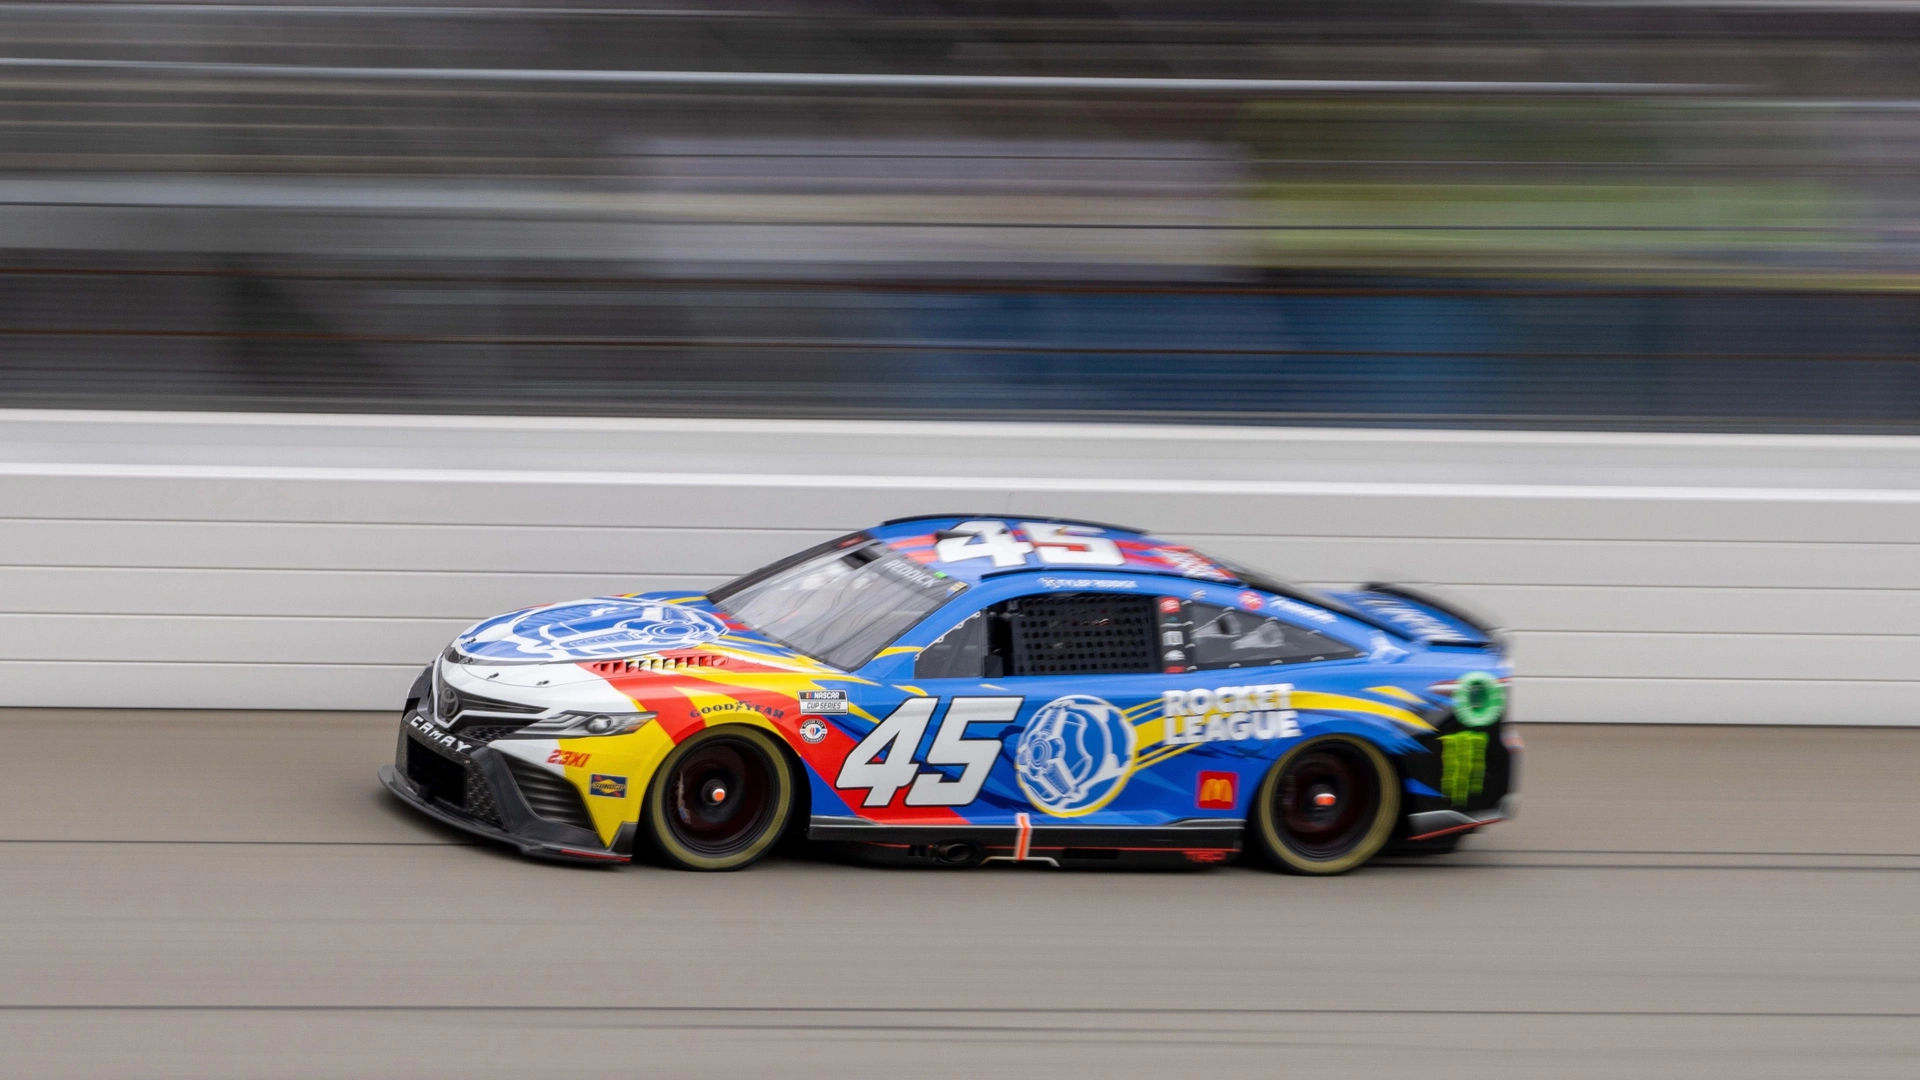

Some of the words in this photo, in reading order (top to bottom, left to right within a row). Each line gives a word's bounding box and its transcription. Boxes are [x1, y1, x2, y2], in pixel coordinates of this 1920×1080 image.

[935, 521, 1126, 568] 45
[882, 560, 936, 588] REDDICK
[819, 702, 841, 710] SERIES
[1162, 683, 1295, 717] ROCKET
[1163, 710, 1302, 745] LEAGUE
[546, 749, 592, 768] 23XI
[834, 695, 1026, 808] 45
